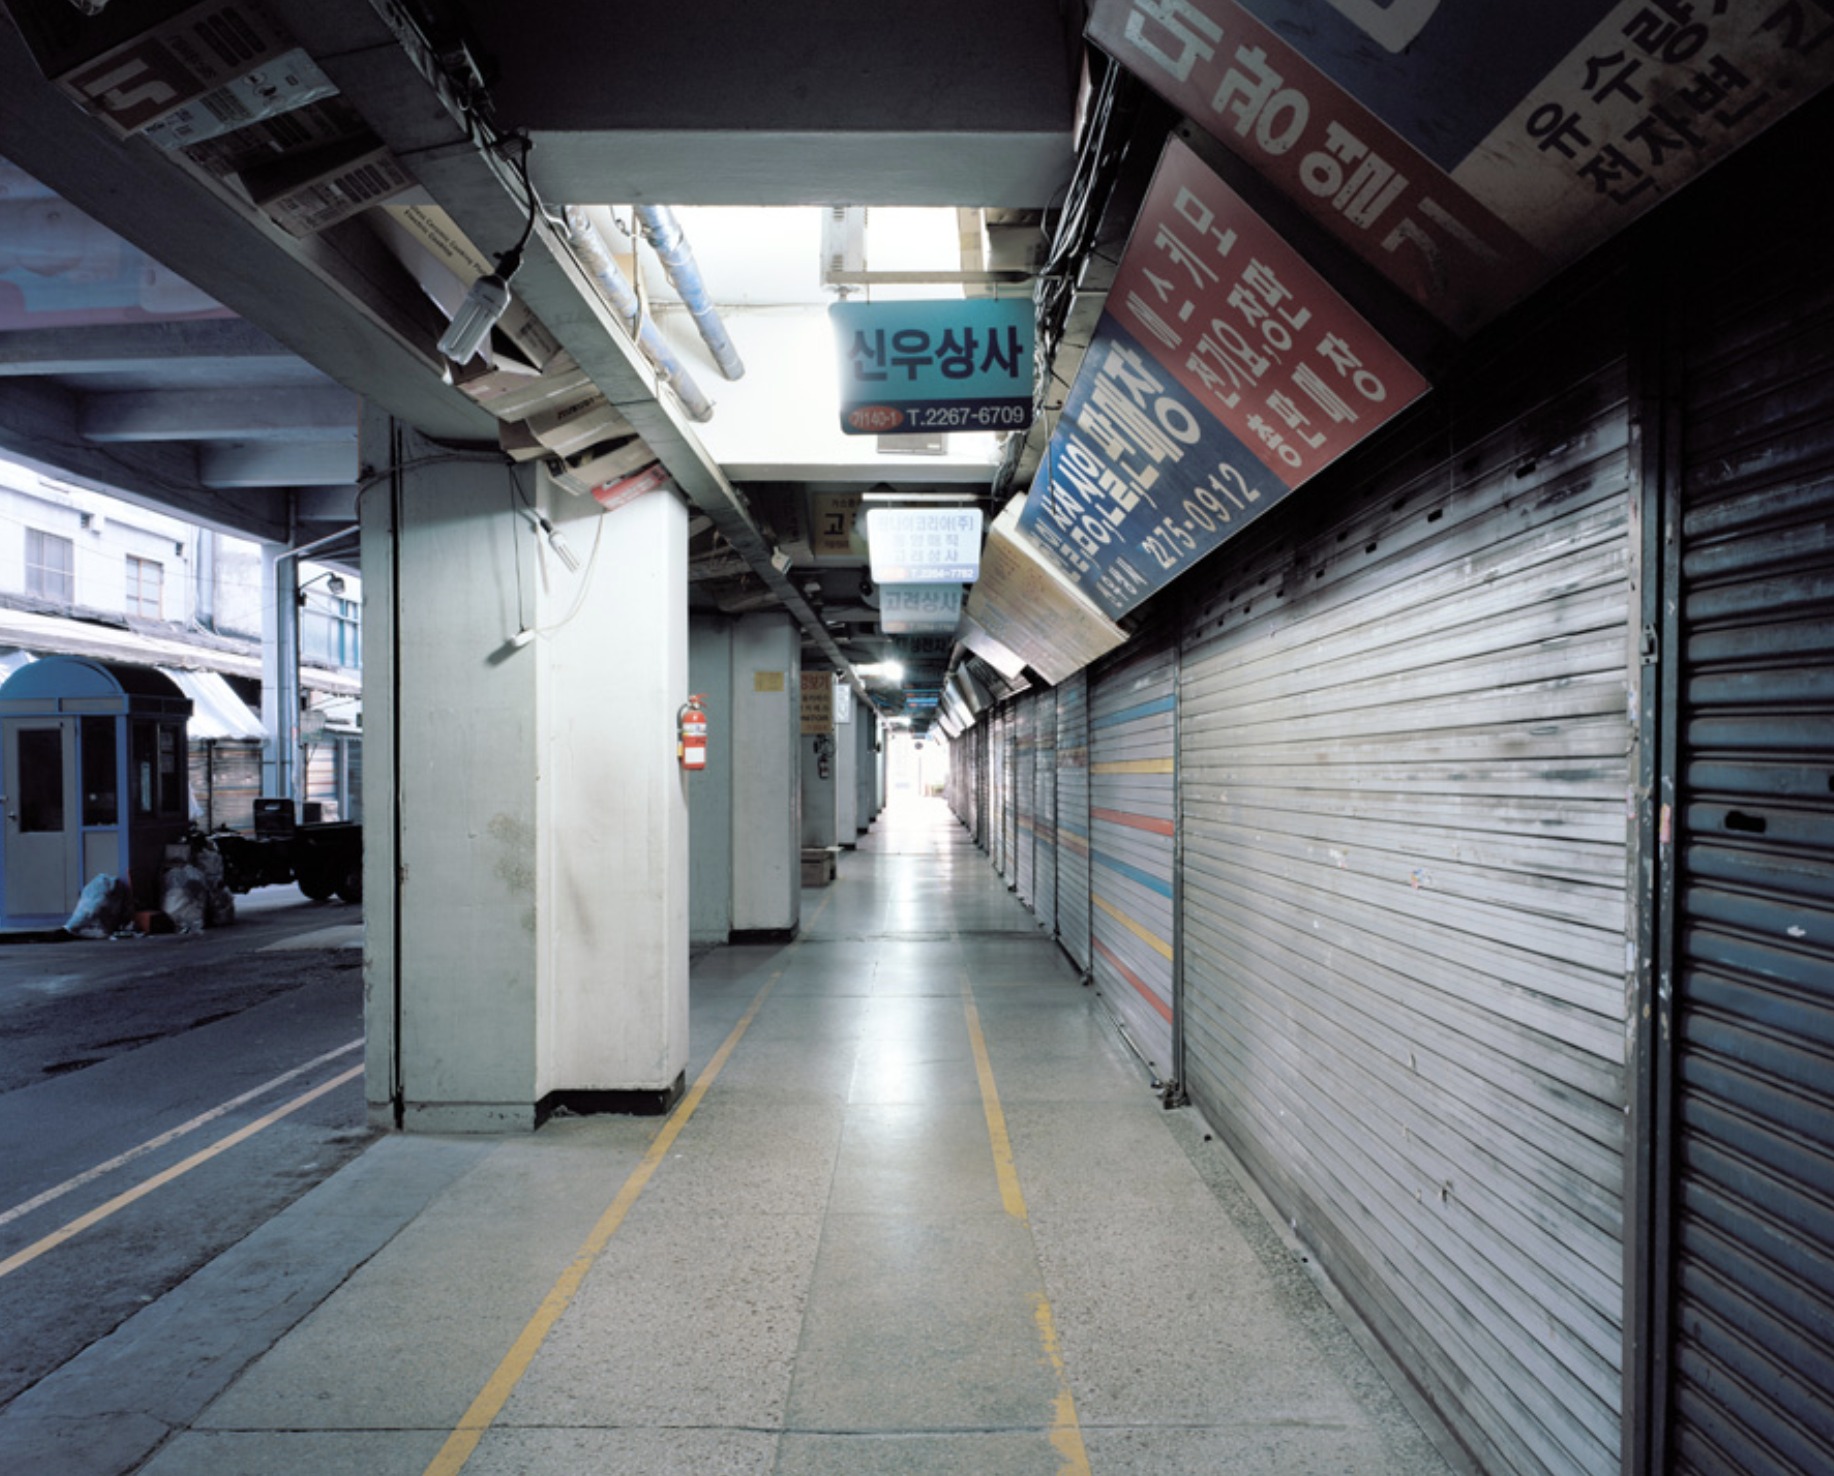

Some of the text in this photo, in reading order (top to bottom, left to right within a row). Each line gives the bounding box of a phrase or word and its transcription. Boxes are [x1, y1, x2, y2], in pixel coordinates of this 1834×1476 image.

[1126, 186, 1237, 350] 에스키모
[848, 325, 1024, 382] 신우상사
[1246, 331, 1387, 468] 총판매장
[906, 405, 1026, 427] T.2267-6709
